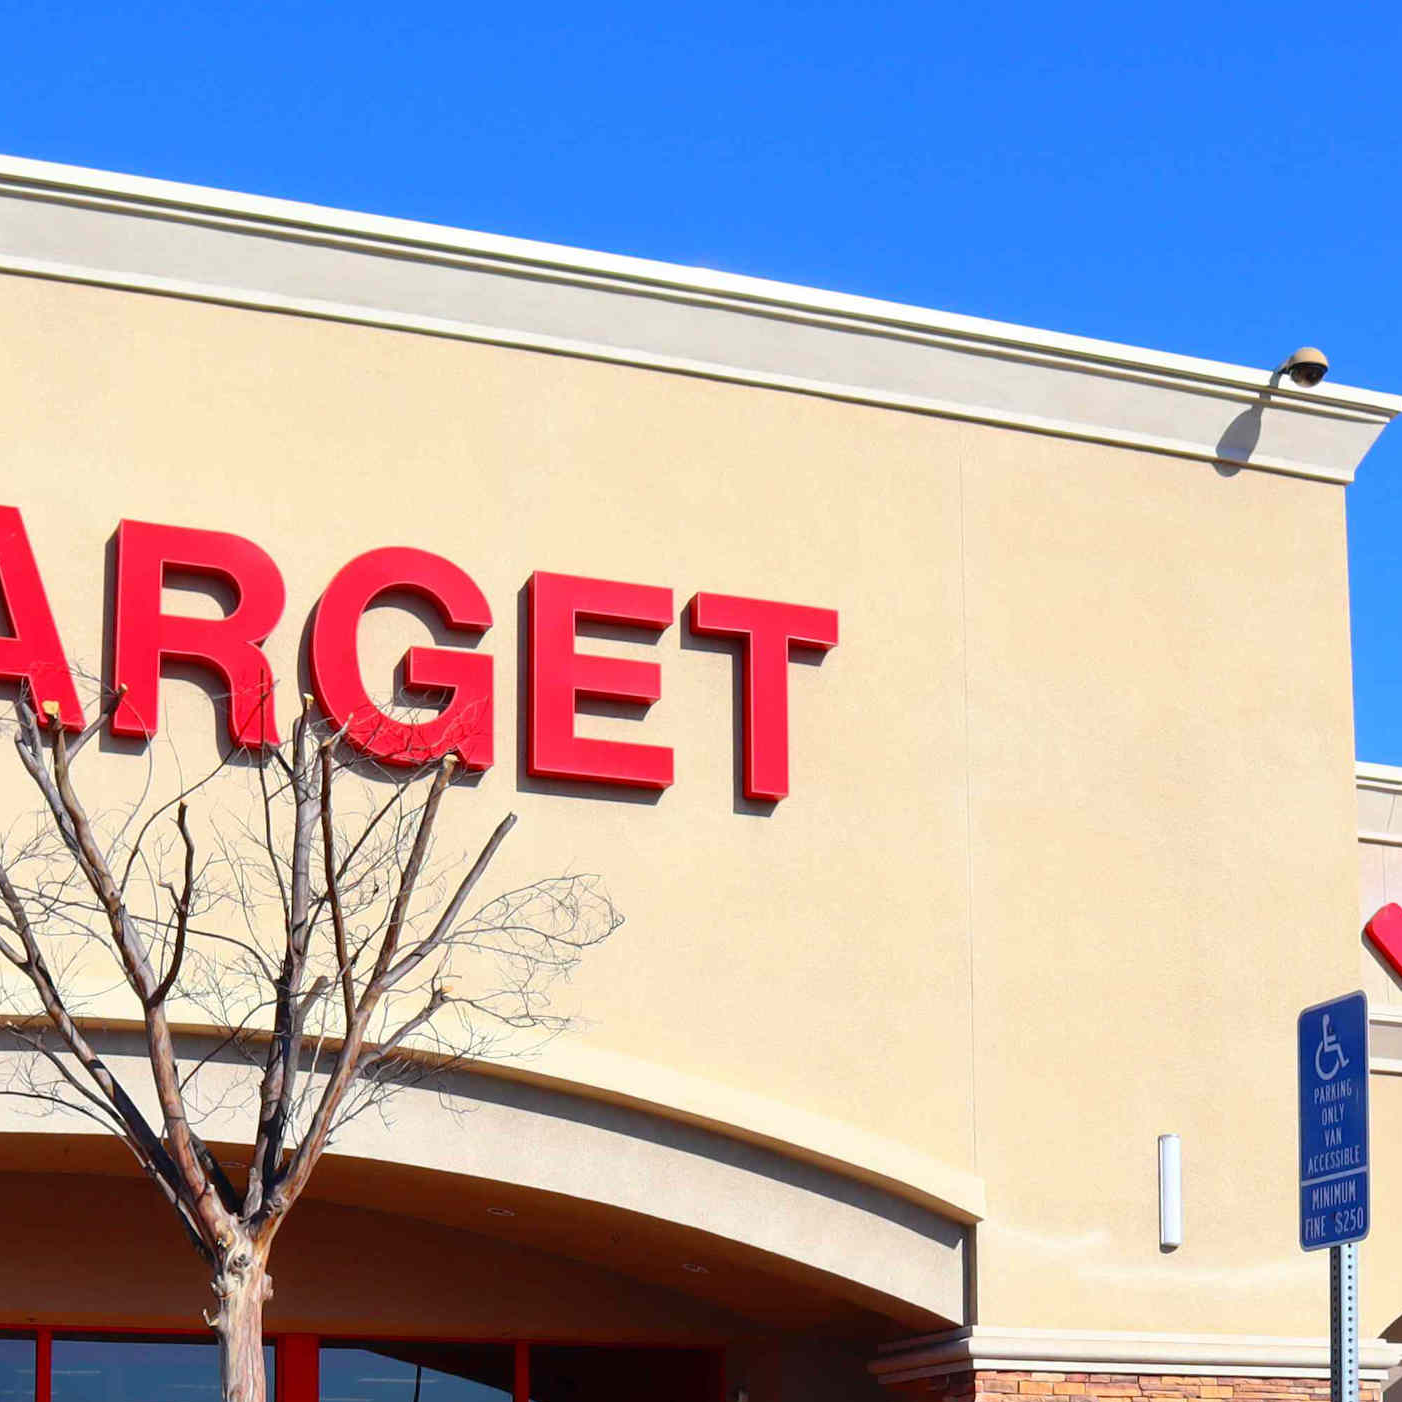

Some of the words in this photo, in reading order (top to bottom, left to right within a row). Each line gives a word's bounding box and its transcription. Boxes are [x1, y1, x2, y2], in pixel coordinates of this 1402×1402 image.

[1314, 1079, 1352, 1104] PARKING
[1321, 1103, 1345, 1126] ONLY
[1324, 1127, 1342, 1147] VAN
[1308, 1144, 1360, 1176] ACCESSIBLE
[1312, 1178, 1356, 1211] MINIMUM
[1305, 1215, 1326, 1240] FINE
[1334, 1206, 1364, 1235] $250
